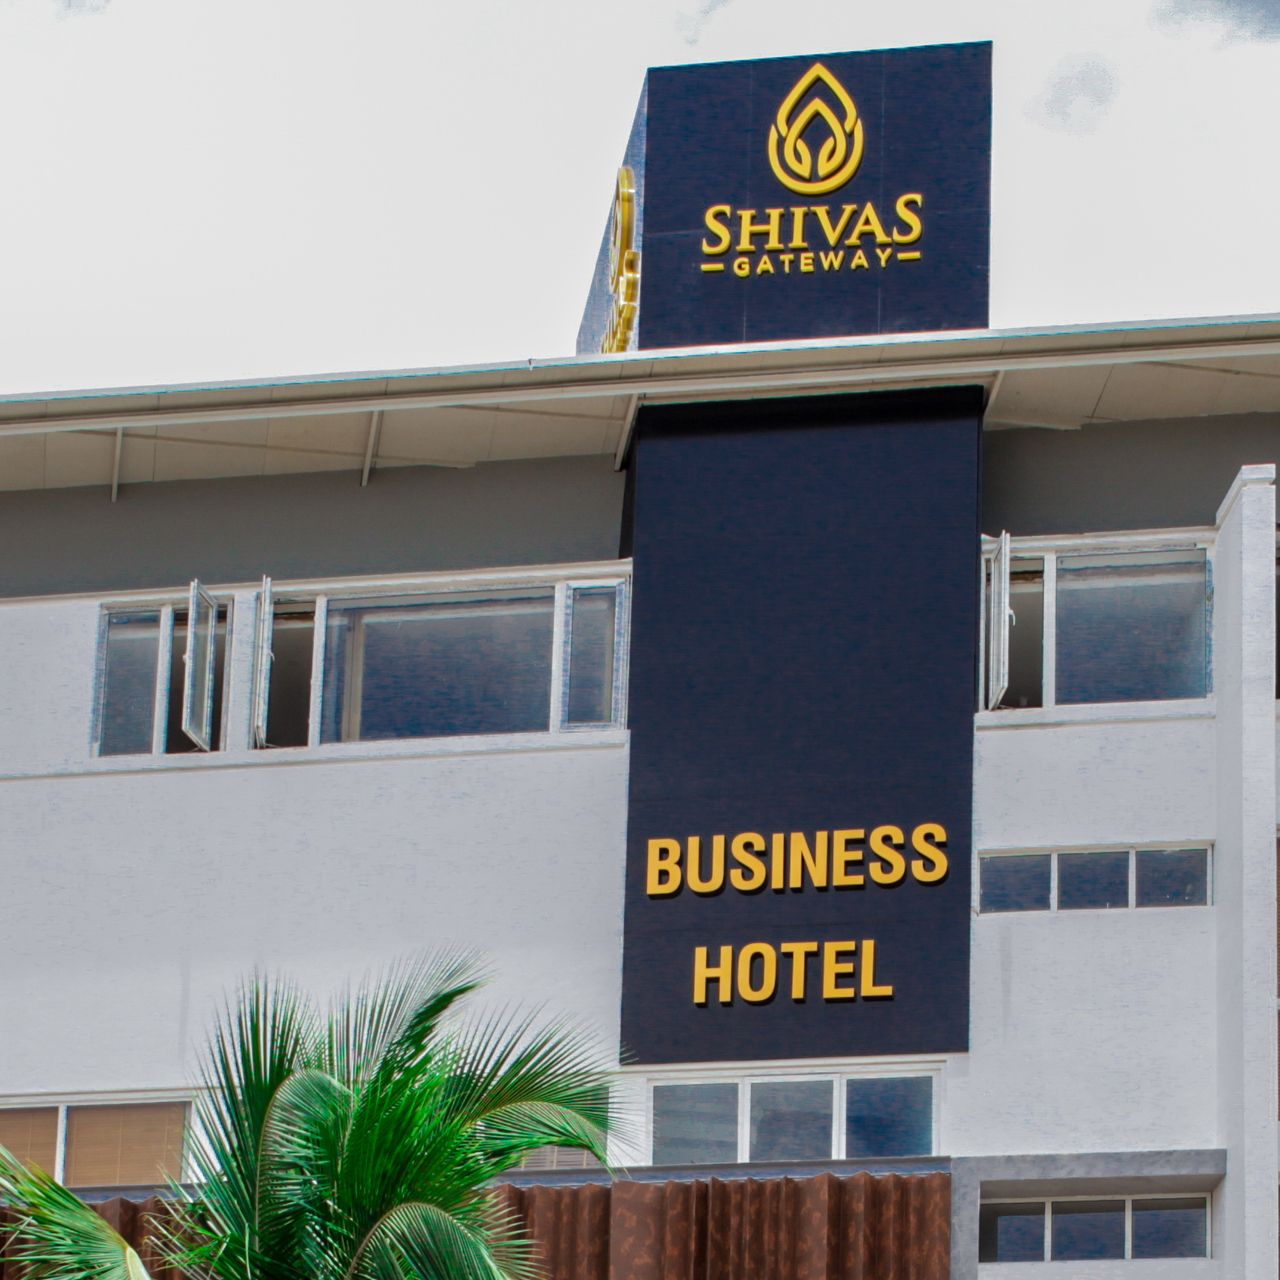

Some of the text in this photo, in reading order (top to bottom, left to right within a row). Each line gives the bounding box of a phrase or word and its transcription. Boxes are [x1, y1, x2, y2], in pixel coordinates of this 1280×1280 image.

[701, 193, 923, 255] SHIVAS
[733, 248, 893, 277] GATEWAY
[646, 822, 949, 896] BUSINESS
[693, 939, 894, 1004] HOTEL
